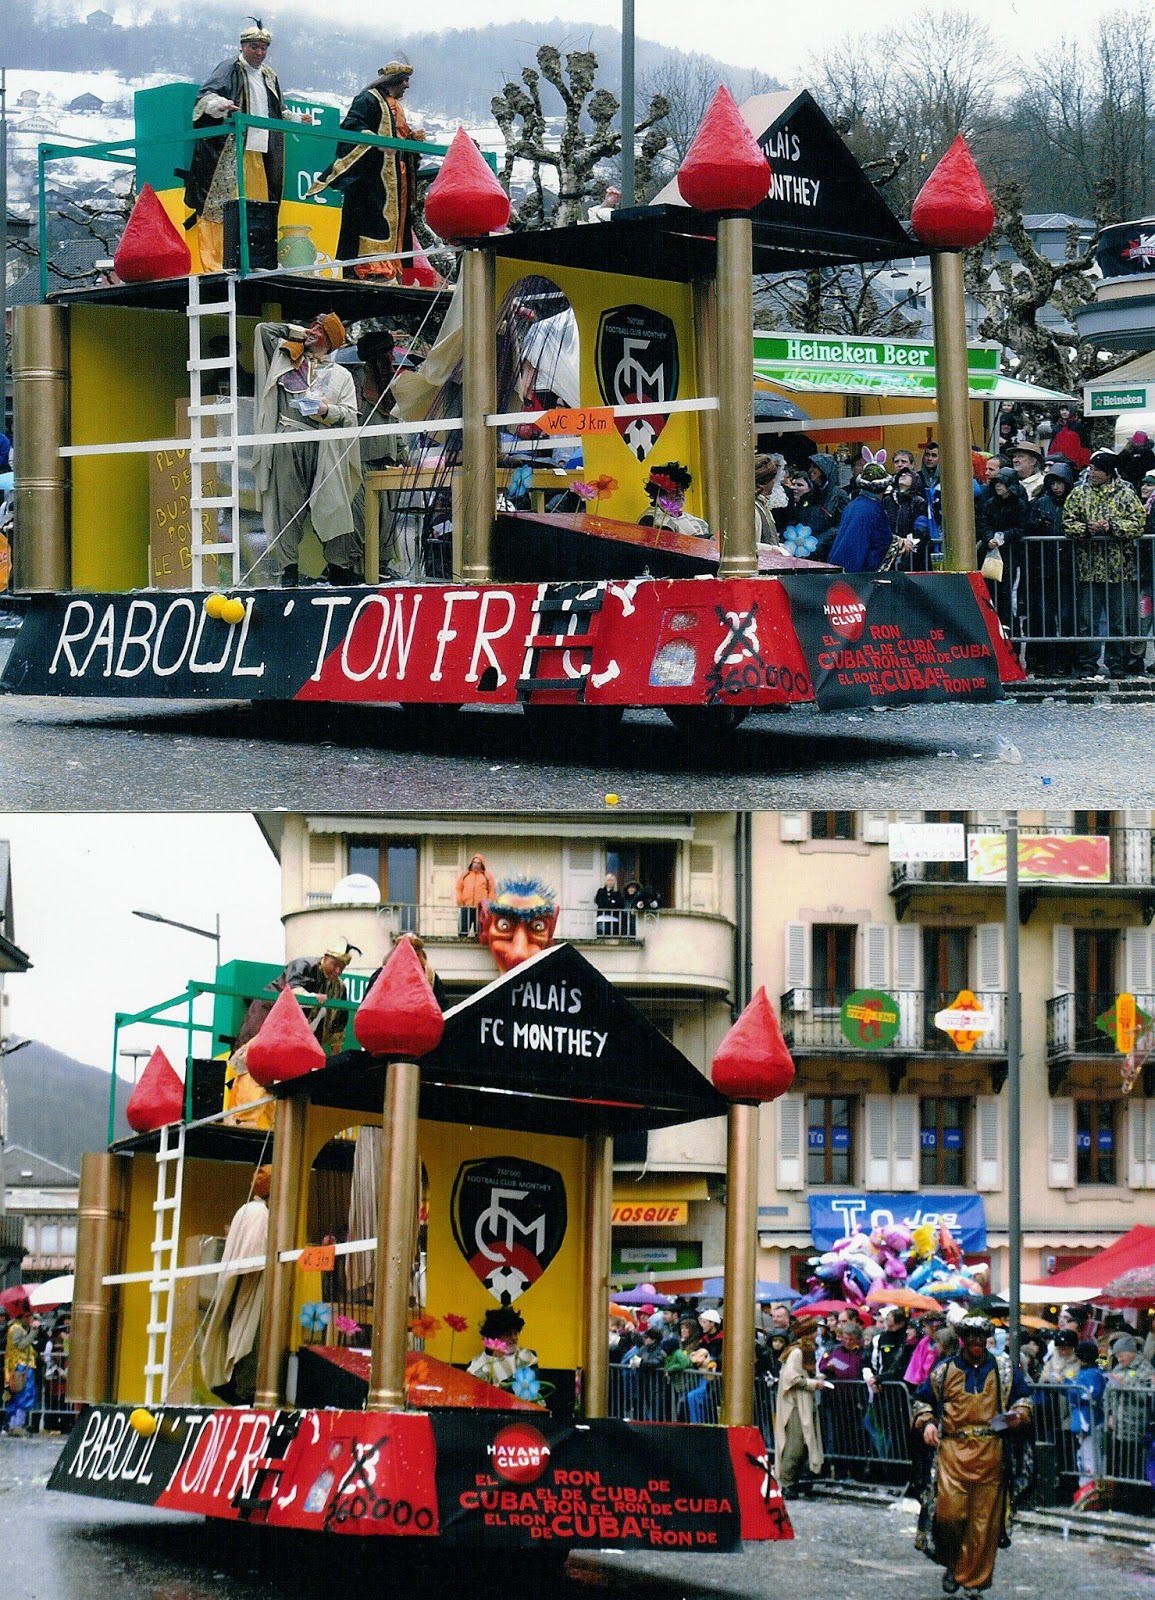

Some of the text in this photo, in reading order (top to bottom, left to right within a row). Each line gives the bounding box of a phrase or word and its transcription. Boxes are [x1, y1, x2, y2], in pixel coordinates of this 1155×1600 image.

[765, 173, 820, 206] ONTHEY
[786, 339, 930, 366] Heineken Beer
[1103, 394, 1143, 406] Heineken
[548, 415, 568, 430] WC
[157, 448, 186, 472] PLU
[156, 480, 215, 528] BUDET
[153, 553, 172, 577] LE
[823, 602, 867, 615] HAVANA
[832, 613, 862, 626] CLUB
[823, 624, 901, 647] EL RON
[930, 629, 944, 641] DE
[818, 644, 991, 671] CUBA RON EL RON DE CUBA
[864, 639, 936, 657] EL DE CUBA
[838, 668, 949, 692] EL RON CUBA EL
[870, 677, 987, 696] DE RON DE
[481, 1017, 608, 1058] FC MONTHEY
[612, 1207, 679, 1222] IOSQUE
[487, 1445, 551, 1456] HAVANA
[498, 1456, 541, 1467] CLUB
[475, 1470, 601, 1486] EL RON
[648, 1479, 671, 1492] DE
[459, 1491, 733, 1516] CUBA RON EL RON DE CUBA
[536, 1486, 652, 1503] EL DE CUBA
[484, 1513, 662, 1539] EL RON CUBA EL
[531, 1526, 718, 1546] DE RON DE
